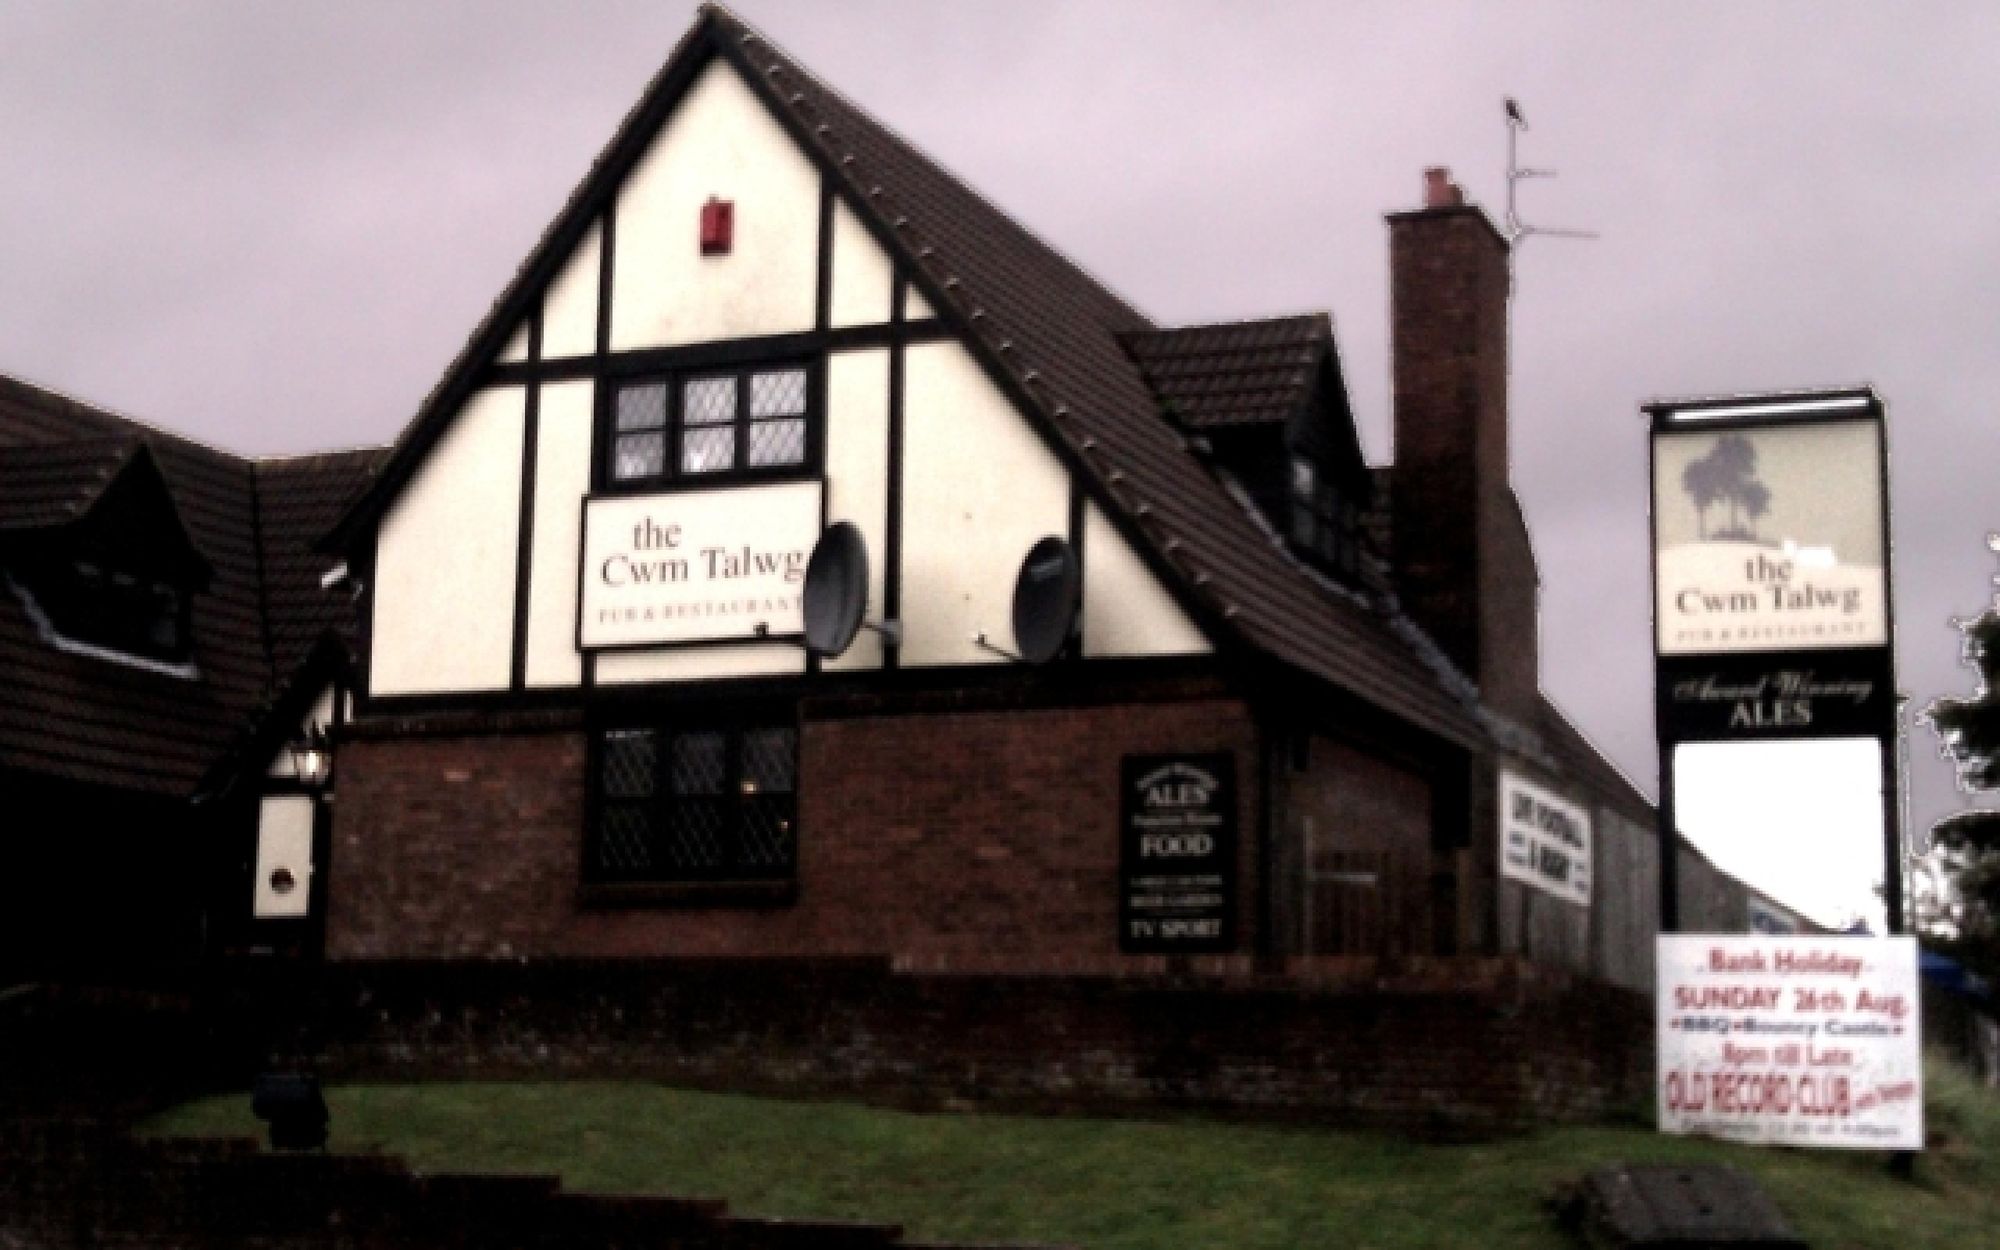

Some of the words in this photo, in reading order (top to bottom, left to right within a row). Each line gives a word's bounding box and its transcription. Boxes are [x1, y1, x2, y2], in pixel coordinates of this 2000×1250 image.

[633, 515, 682, 550] the
[601, 552, 689, 587] Cwm
[700, 546, 804, 584] Talwg
[1746, 553, 1793, 581] the
[1676, 587, 1757, 614] Cwm
[1765, 582, 1861, 614] Talwg
[599, 605, 638, 624] PUB
[1729, 700, 1813, 728] ALES
[1144, 784, 1209, 806] ALES
[1141, 834, 1214, 857] FOOD
[1710, 948, 1766, 972] Bank
[1775, 949, 1863, 979] Holiday
[1675, 985, 1781, 1010] SUNDAY
[1666, 1072, 1706, 1114] OLD
[1711, 1072, 1791, 1116] RECORD
[1798, 1075, 1851, 1118] CLUB
